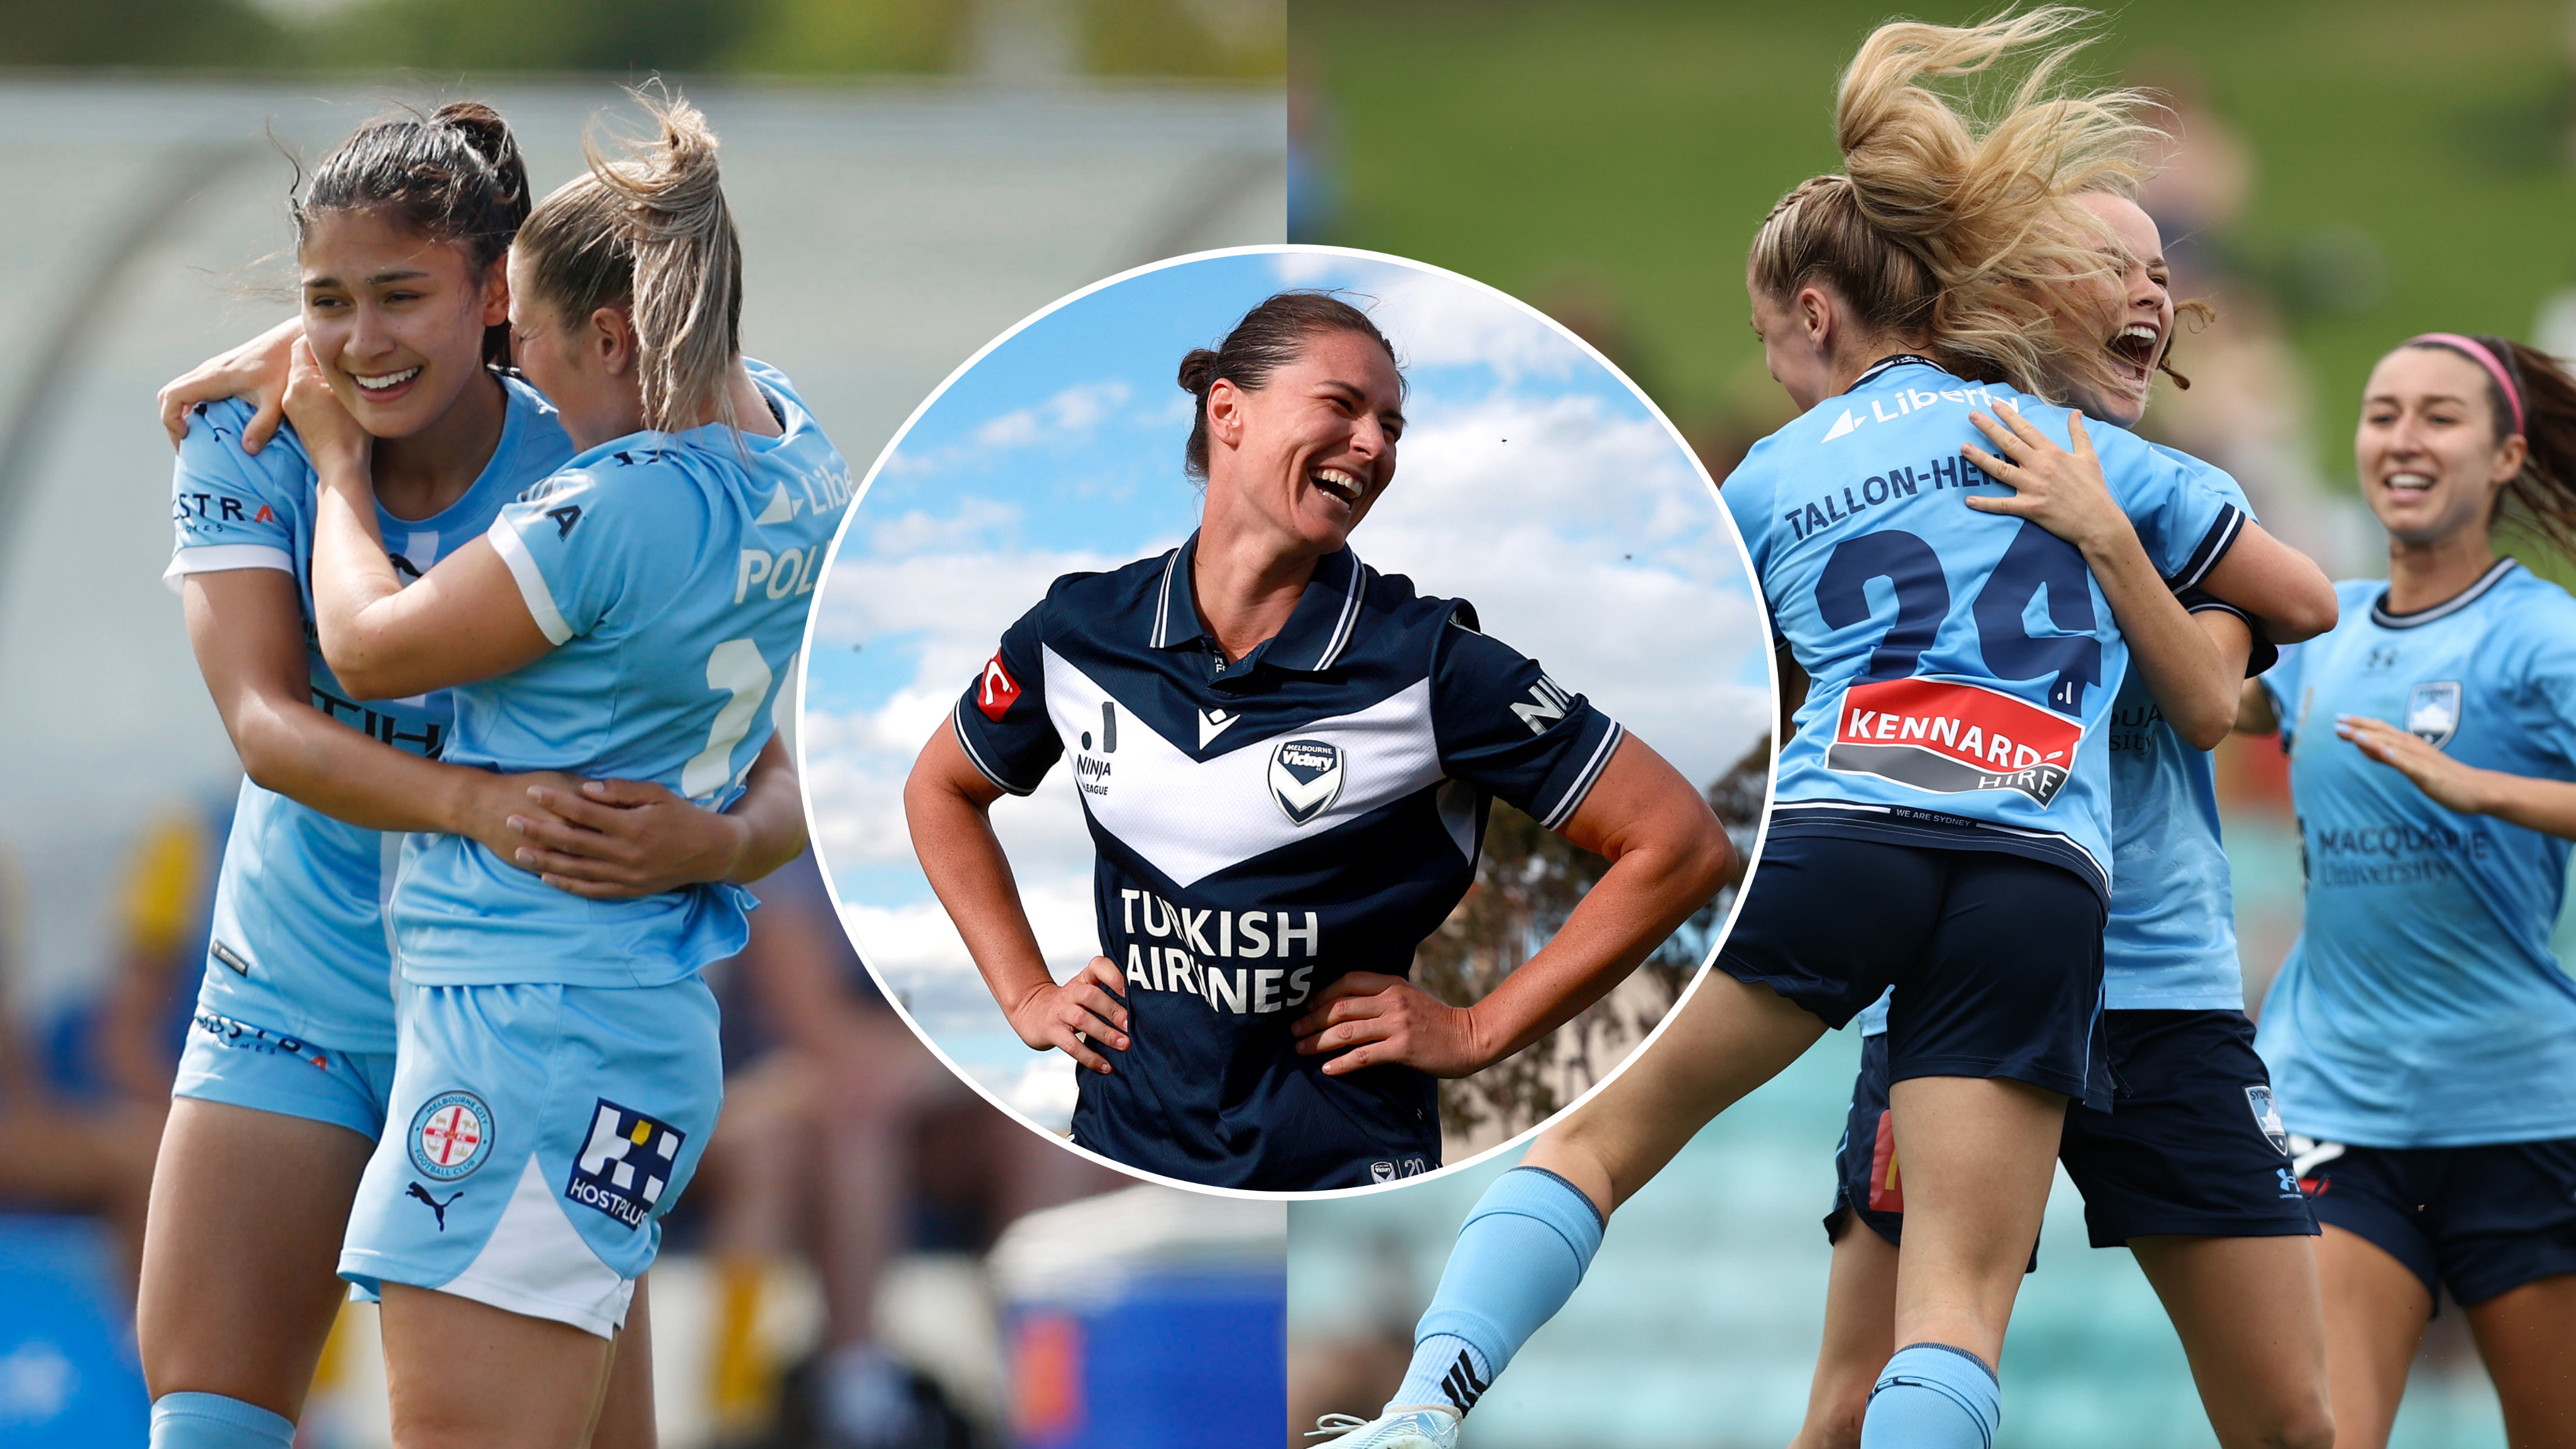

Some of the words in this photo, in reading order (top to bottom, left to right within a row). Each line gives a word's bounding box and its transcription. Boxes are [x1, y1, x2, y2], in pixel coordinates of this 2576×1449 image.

[1871, 386, 2019, 423] Liberty
[1814, 519, 2102, 718] 24
[1283, 750, 1334, 772] Victory
[1286, 744, 1333, 755] MELBOURNE
[1077, 753, 1111, 782] NINJA
[1978, 769, 2058, 797] HIRE
[1896, 809, 1911, 818] WE
[1913, 812, 1931, 821] ARE
[1933, 815, 1971, 826] SYDNEY
[1121, 889, 1318, 958] TURKISH
[426, 1096, 477, 1114] MELBOURNE
[475, 1106, 488, 1124] CITY
[415, 1148, 451, 1176] FOOTBALL
[453, 1159, 475, 1175] CLUB
